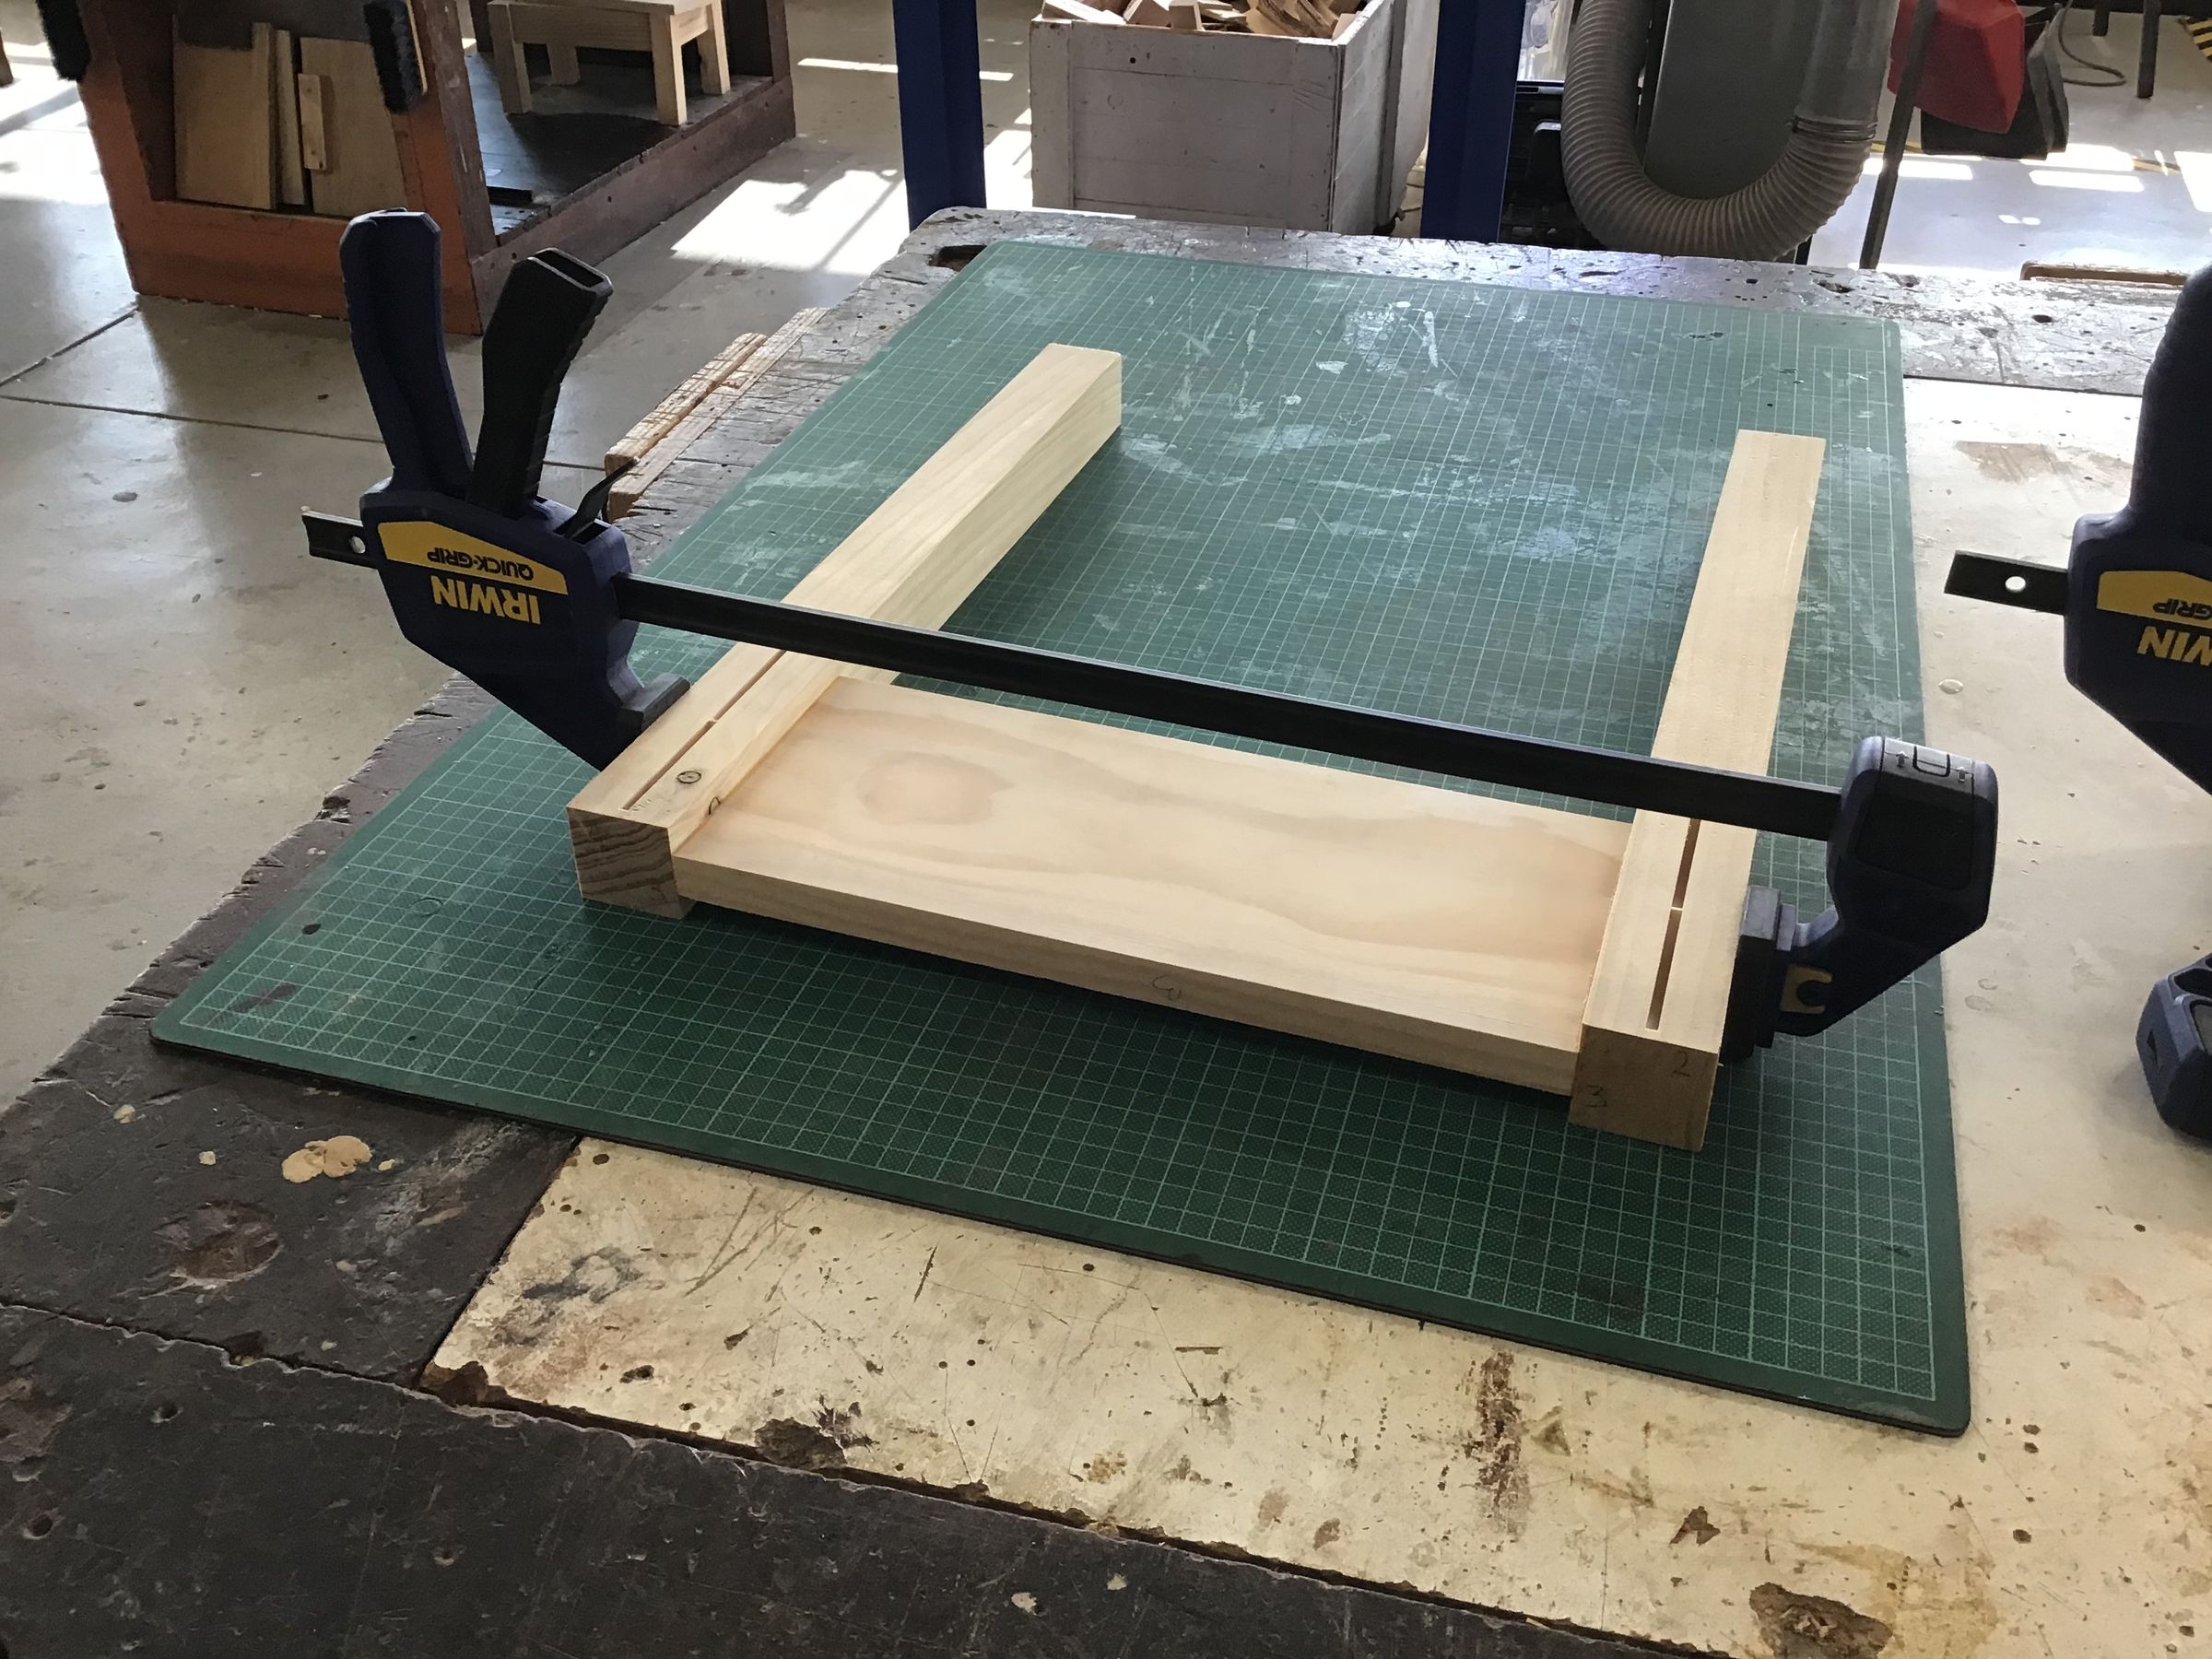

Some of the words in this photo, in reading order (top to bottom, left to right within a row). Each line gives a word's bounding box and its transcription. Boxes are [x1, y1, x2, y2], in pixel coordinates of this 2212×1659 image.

[430, 575, 541, 625] IRWIN
[1673, 1050, 1690, 1077] 2
[1585, 1084, 1607, 1108] 3
